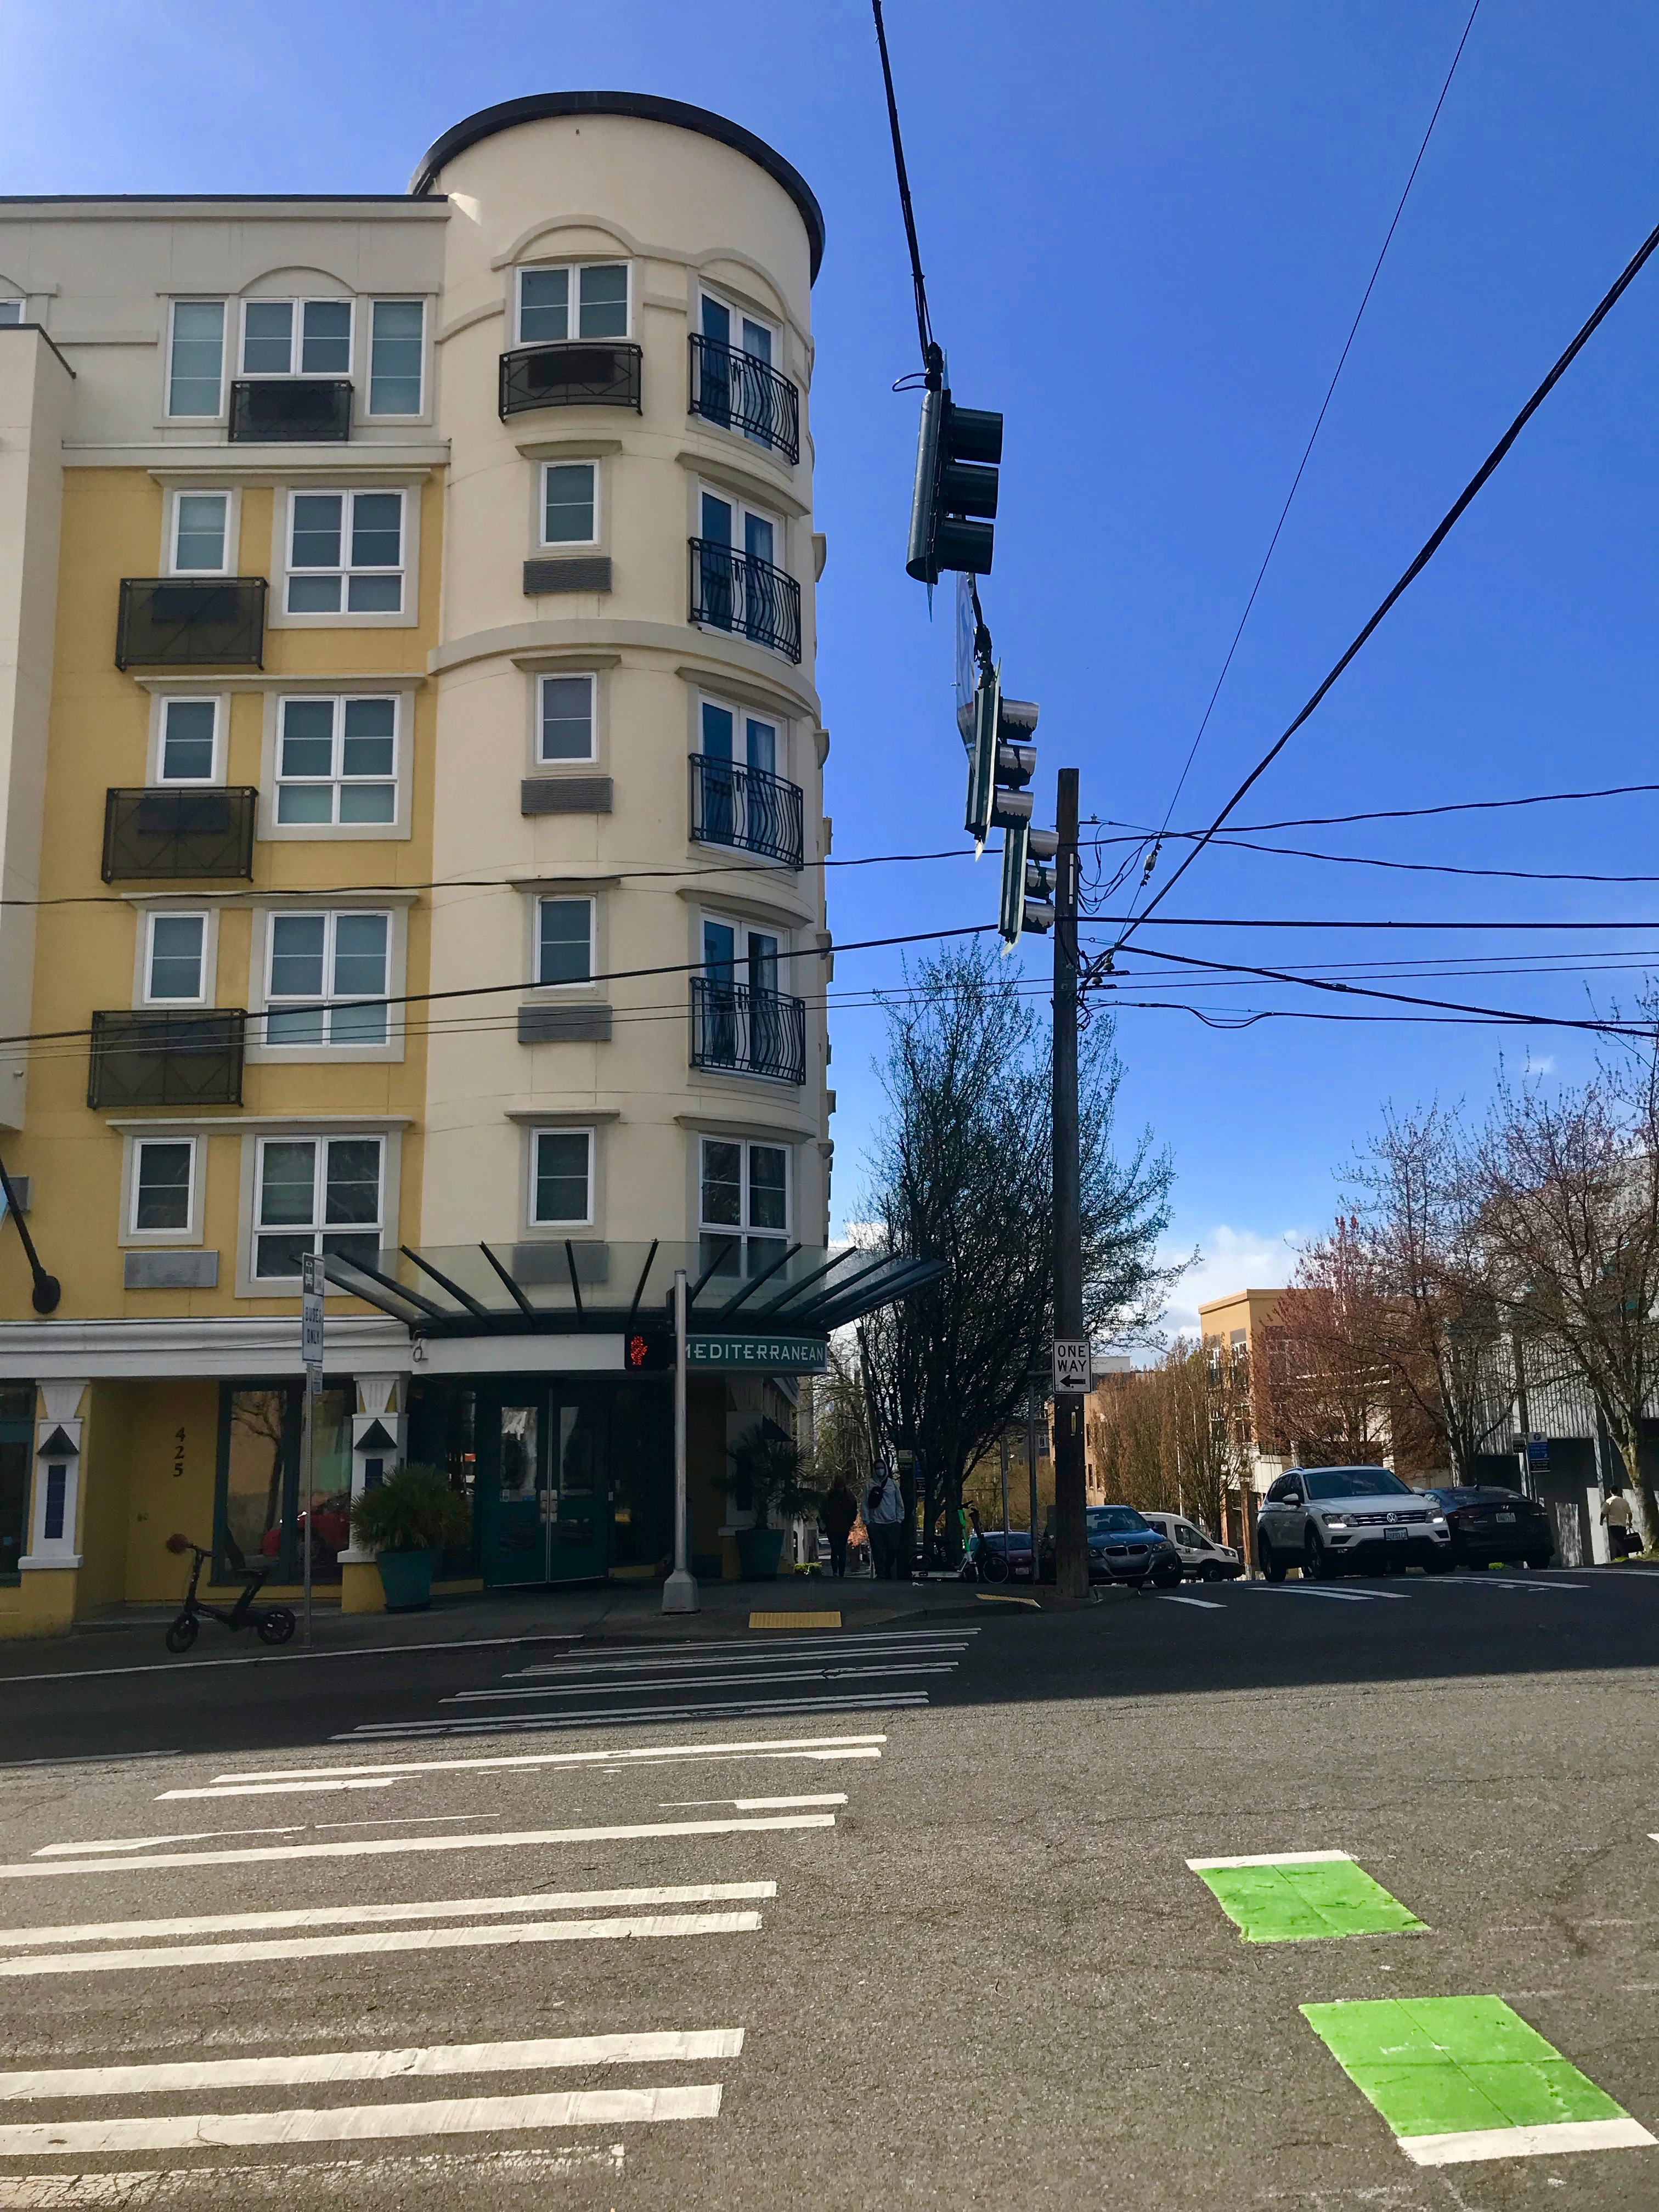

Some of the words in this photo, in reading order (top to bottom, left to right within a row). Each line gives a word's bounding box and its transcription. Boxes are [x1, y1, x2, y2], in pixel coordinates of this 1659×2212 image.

[1058, 1345, 1086, 1357] ONE
[1058, 1360, 1087, 1372] WAY
[173, 1426, 185, 1477] 425
